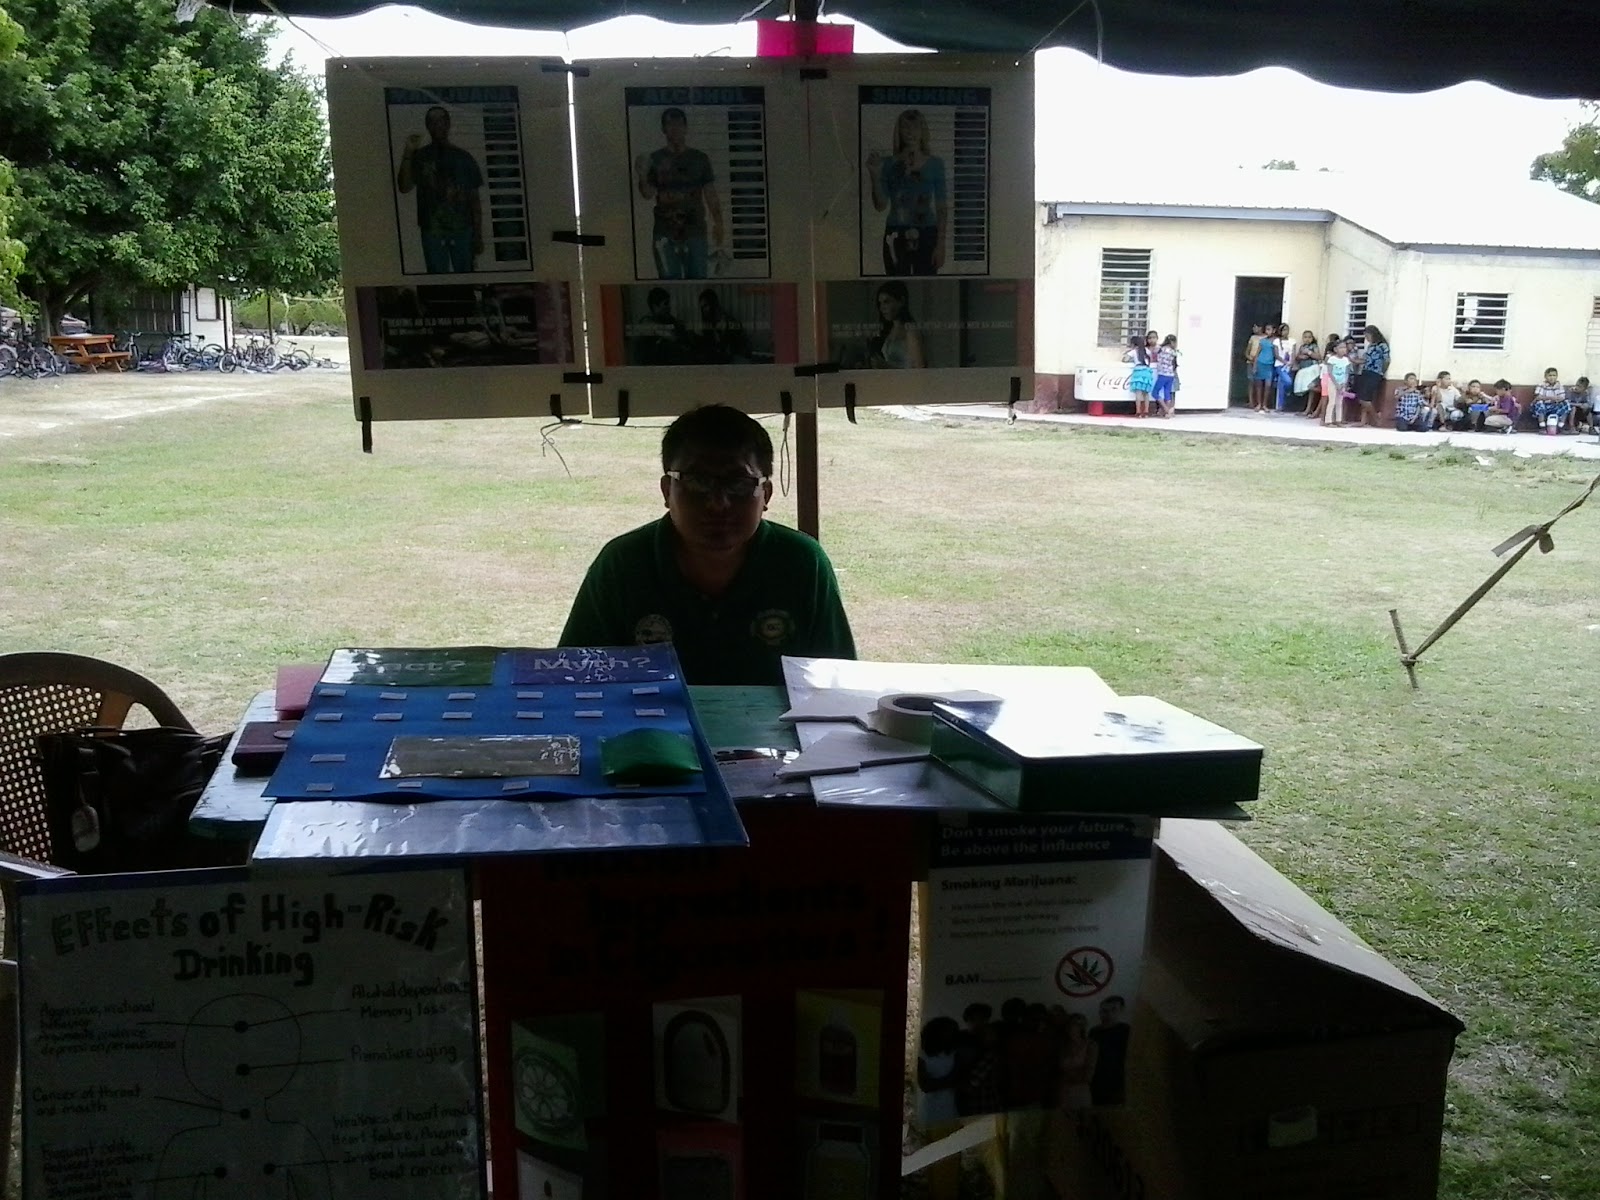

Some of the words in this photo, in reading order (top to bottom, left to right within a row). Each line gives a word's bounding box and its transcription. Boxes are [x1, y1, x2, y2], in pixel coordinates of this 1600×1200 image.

[941, 825, 983, 840] Don't
[986, 823, 1036, 838] smoke
[1039, 824, 1076, 838] your
[1077, 820, 1130, 834] future.
[940, 844, 961, 858] Be
[962, 842, 1010, 857] above
[1012, 840, 1038, 854] the
[1040, 837, 1112, 853] influence
[941, 876, 1002, 892] Smoking
[1003, 873, 1078, 890] Marijuana:
[199, 892, 247, 938] of
[261, 892, 449, 952] High-Risk
[172, 940, 315, 987] Drinking
[351, 981, 396, 1001] Alcohol
[360, 1005, 414, 1023] Memory
[416, 1002, 447, 1017] loss
[416, 1043, 458, 1065] aging
[31, 1086, 76, 1102] Cancer
[98, 1082, 142, 1099] throat
[406, 1102, 440, 1122] heart
[409, 1164, 456, 1179] cancer
